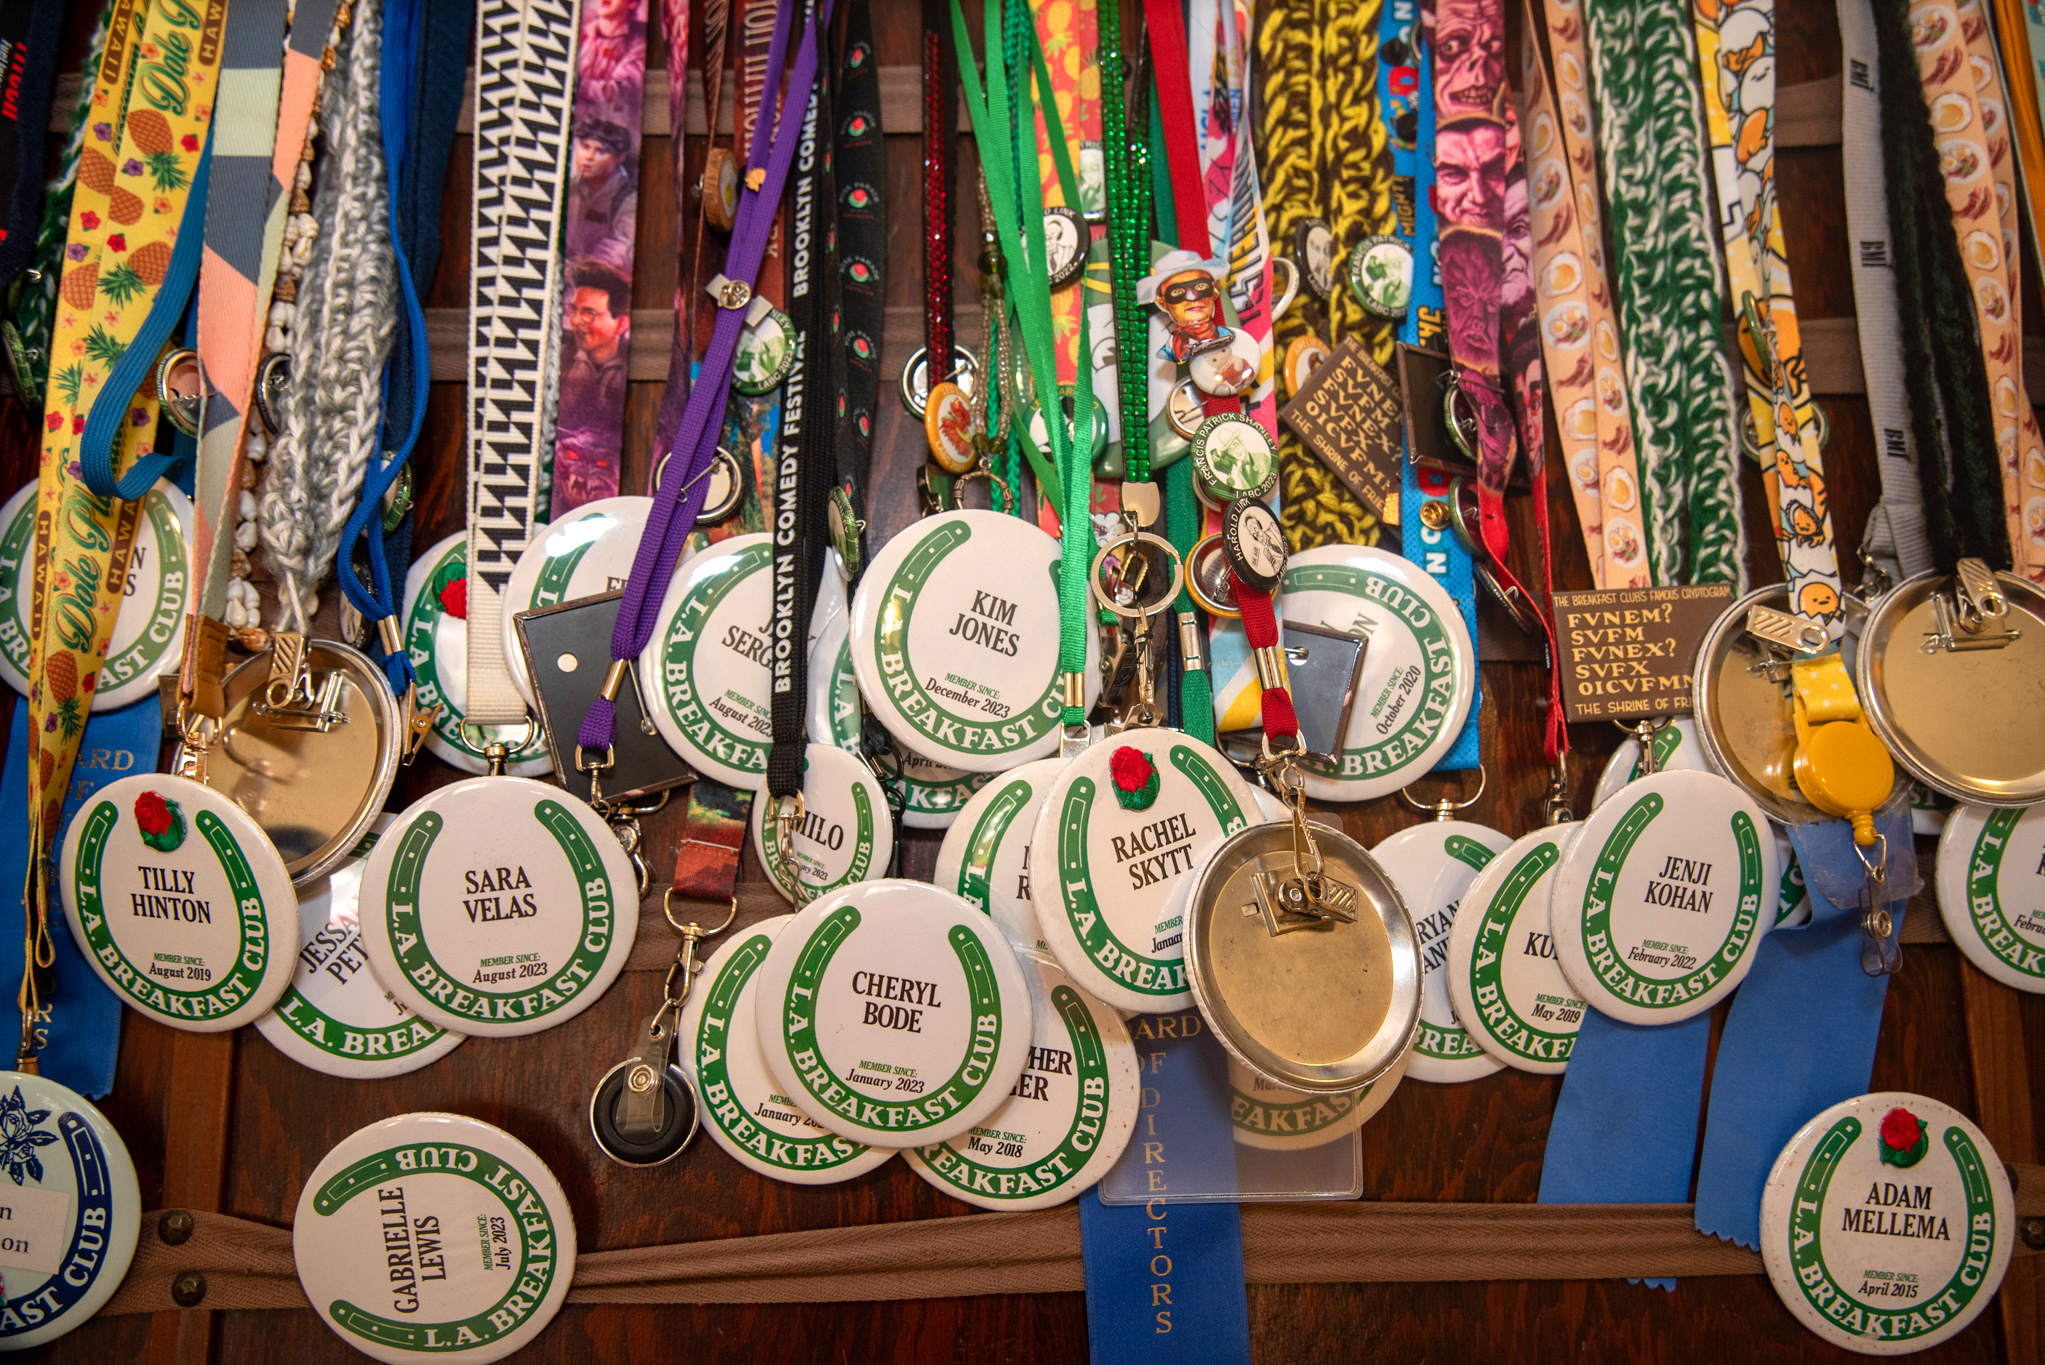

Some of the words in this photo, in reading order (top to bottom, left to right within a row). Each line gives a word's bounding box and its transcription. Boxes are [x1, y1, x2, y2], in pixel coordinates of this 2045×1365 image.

[137, 31, 193, 116] Dole
[793, 176, 812, 298] BROOKLYN
[783, 330, 807, 437] FESTIVAL
[1356, 353, 1395, 388] BREAKFAST
[1332, 368, 1391, 429] SVFM
[1199, 412, 1237, 438] PATRICK
[1238, 413, 1278, 451] SHANLEY
[1313, 389, 1374, 452] SVFX
[1322, 376, 1403, 463] FVNEX?
[1195, 438, 1218, 486] FRANCIS
[1290, 408, 1314, 435] THE
[1313, 434, 1349, 473] SHRINE
[1348, 471, 1364, 486] OF
[776, 445, 798, 546] COMEDY
[1261, 471, 1278, 493] 2023
[1234, 497, 1251, 514] LINK
[1229, 513, 1244, 561] HAROLD
[32, 519, 50, 633] HAWAII
[53, 553, 102, 655] Dole
[149, 570, 185, 644] CLUB
[969, 589, 1019, 628] KIM
[1364, 575, 1431, 629] CLUB
[1553, 595, 1570, 608] THE
[1572, 593, 1617, 606] BREAKFAST
[1619, 591, 1648, 604] CLUB'S
[1649, 589, 1680, 601] FAMOUS
[1681, 586, 1732, 600] CRYPTOGRAM
[1567, 602, 1673, 628] FVNEM?
[666, 597, 709, 653] L.A.
[774, 555, 796, 694] BROOKLYN
[948, 612, 1021, 659] JONES
[1570, 626, 1645, 646] SVFM
[1571, 637, 1677, 662] FVNEX?
[1575, 660, 1650, 679] SVFX
[724, 689, 751, 708] MEMBER
[880, 650, 1038, 750] BREAKFAST
[924, 677, 980, 709] December
[980, 698, 1011, 719] 2023
[944, 672, 978, 691] MEMBER
[976, 684, 1001, 701] SINCE:
[1341, 636, 1452, 776] BREAKFAST
[1370, 683, 1390, 719] MEMBER
[1375, 694, 1406, 735] October
[1398, 664, 1422, 700] 2020
[709, 696, 751, 730] August
[1575, 702, 1602, 716] THE
[1607, 699, 1651, 714] SHRINE
[1654, 698, 1670, 711] OF
[789, 804, 844, 851] MILO
[1110, 812, 1197, 864] RACHEL
[137, 865, 197, 895] TILLY
[847, 841, 871, 884] CLUB
[1128, 843, 1195, 891] SKYTT
[1658, 855, 1714, 887] JENJI
[1970, 831, 2004, 889] L.A.
[463, 865, 533, 896] SARA
[1585, 866, 1615, 929] L.A.
[1643, 884, 1715, 915] KOHAN
[130, 893, 213, 925] HINTON
[462, 893, 538, 924] VELAS
[1066, 877, 1098, 947] L.A.
[1721, 892, 1760, 964] CLUB
[78, 880, 101, 942] L.A.
[98, 938, 253, 1018] BREAKFAST
[242, 896, 266, 972] CLUB
[153, 952, 182, 966] MEMBER
[182, 954, 206, 967] SINCE:
[391, 900, 418, 964] L.A.
[408, 958, 595, 1021] BREAKFAST
[584, 876, 612, 954] CLUB
[479, 955, 513, 968] MEMBER
[514, 952, 542, 965] SINCE:
[1475, 917, 1507, 979] L.A.
[1586, 927, 1721, 1005] BREAKFAST
[1627, 945, 1671, 970] February
[1672, 950, 1697, 970] 2022
[1641, 938, 1671, 953] MEMBER
[1670, 943, 1690, 955] SINCE:
[148, 962, 183, 981] August
[186, 967, 212, 982] 2019
[472, 968, 517, 985] August
[519, 962, 549, 978] 2023
[851, 970, 942, 1009] CHERYL
[788, 981, 814, 1044] L.A.
[862, 1001, 923, 1035] BODE
[1531, 1003, 1555, 1022] May
[1555, 1008, 1581, 1024] 2019
[1534, 993, 1565, 1007] MEMBER
[279, 996, 333, 1048] L.A.
[701, 1012, 726, 1080] L.A.
[961, 1012, 998, 1086] CLUB
[793, 1047, 957, 1128] BREAKFAST
[845, 1068, 894, 1093] January
[894, 1077, 925, 1094] 2023
[858, 1059, 892, 1074] MEMBER
[892, 1065, 918, 1078] SINCE:
[754, 1102, 802, 1127] January
[917, 1138, 1074, 1196] REAKFAST
[1070, 1075, 1105, 1150] CLUB
[967, 1135, 995, 1155] May
[995, 1141, 1024, 1159] 2018
[968, 1126, 1001, 1140] MEMBER
[1001, 1131, 1027, 1145] SINCE:
[395, 1148, 478, 1175] CLUB
[1865, 1180, 1933, 1211] ADAM
[479, 1213, 491, 1240] SINCE:
[490, 1216, 508, 1245] 2023
[1793, 1194, 1819, 1262] L.A.
[1841, 1207, 1951, 1242] MELLEMA
[64, 1206, 106, 1287] CLUB
[378, 1186, 420, 1315] GABRIELLE
[416, 1215, 447, 1281] LEWIS
[423, 1323, 491, 1350] L.A.
[482, 1160, 552, 1334] BREAKFAST
[484, 1240, 495, 1271] MEMBER
[494, 1245, 512, 1271] July
[1960, 1211, 1992, 1288] CLUB
[1858, 1280, 1892, 1299] April
[1893, 1283, 1919, 1299] 2015
[1863, 1269, 1895, 1281] MEMBER
[1895, 1271, 1919, 1283] SINCE:
[1799, 1264, 1961, 1341] BREAKFAST
